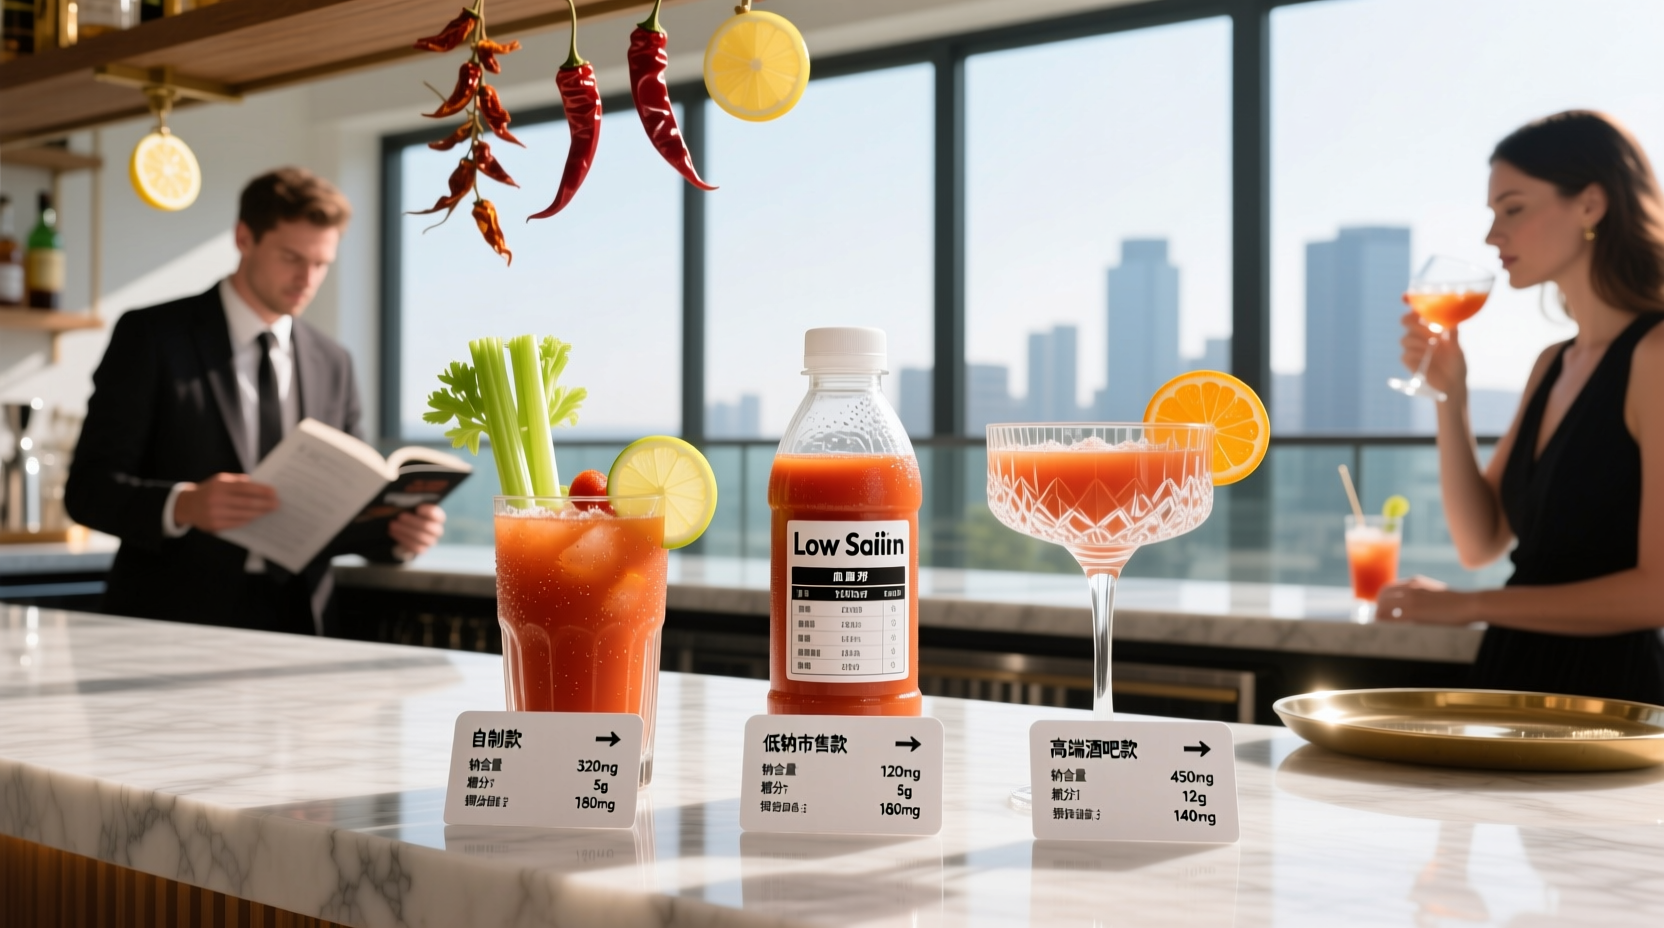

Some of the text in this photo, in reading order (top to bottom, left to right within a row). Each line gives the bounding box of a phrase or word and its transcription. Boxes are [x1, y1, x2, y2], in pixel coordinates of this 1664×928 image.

[793, 531, 840, 556] Low
[472, 727, 522, 749] 自制款
[593, 779, 609, 794] 5g
[897, 784, 912, 799] 5g
[575, 796, 615, 813] 180mg
[1182, 790, 1207, 807] 12g
